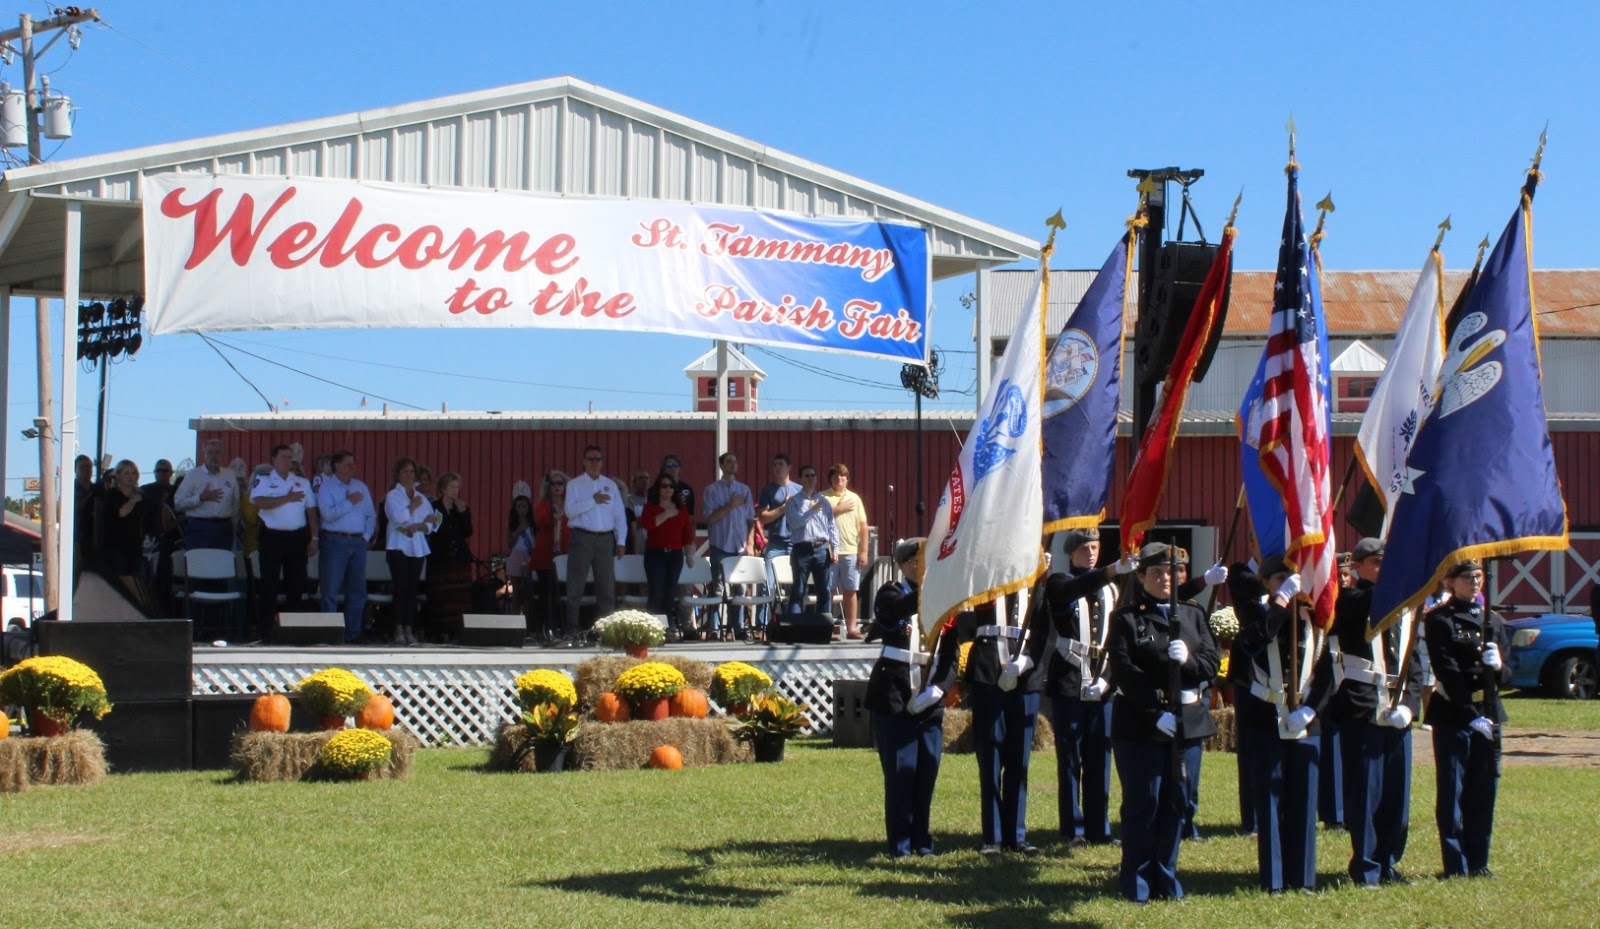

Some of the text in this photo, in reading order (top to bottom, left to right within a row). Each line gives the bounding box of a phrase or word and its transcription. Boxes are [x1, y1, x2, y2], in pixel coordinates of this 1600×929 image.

[160, 186, 579, 275] Welcome
[631, 218, 893, 281] St. Tammany
[445, 277, 637, 319] to the
[696, 284, 921, 343] Parish Fair
[951, 463, 962, 513] TATES
